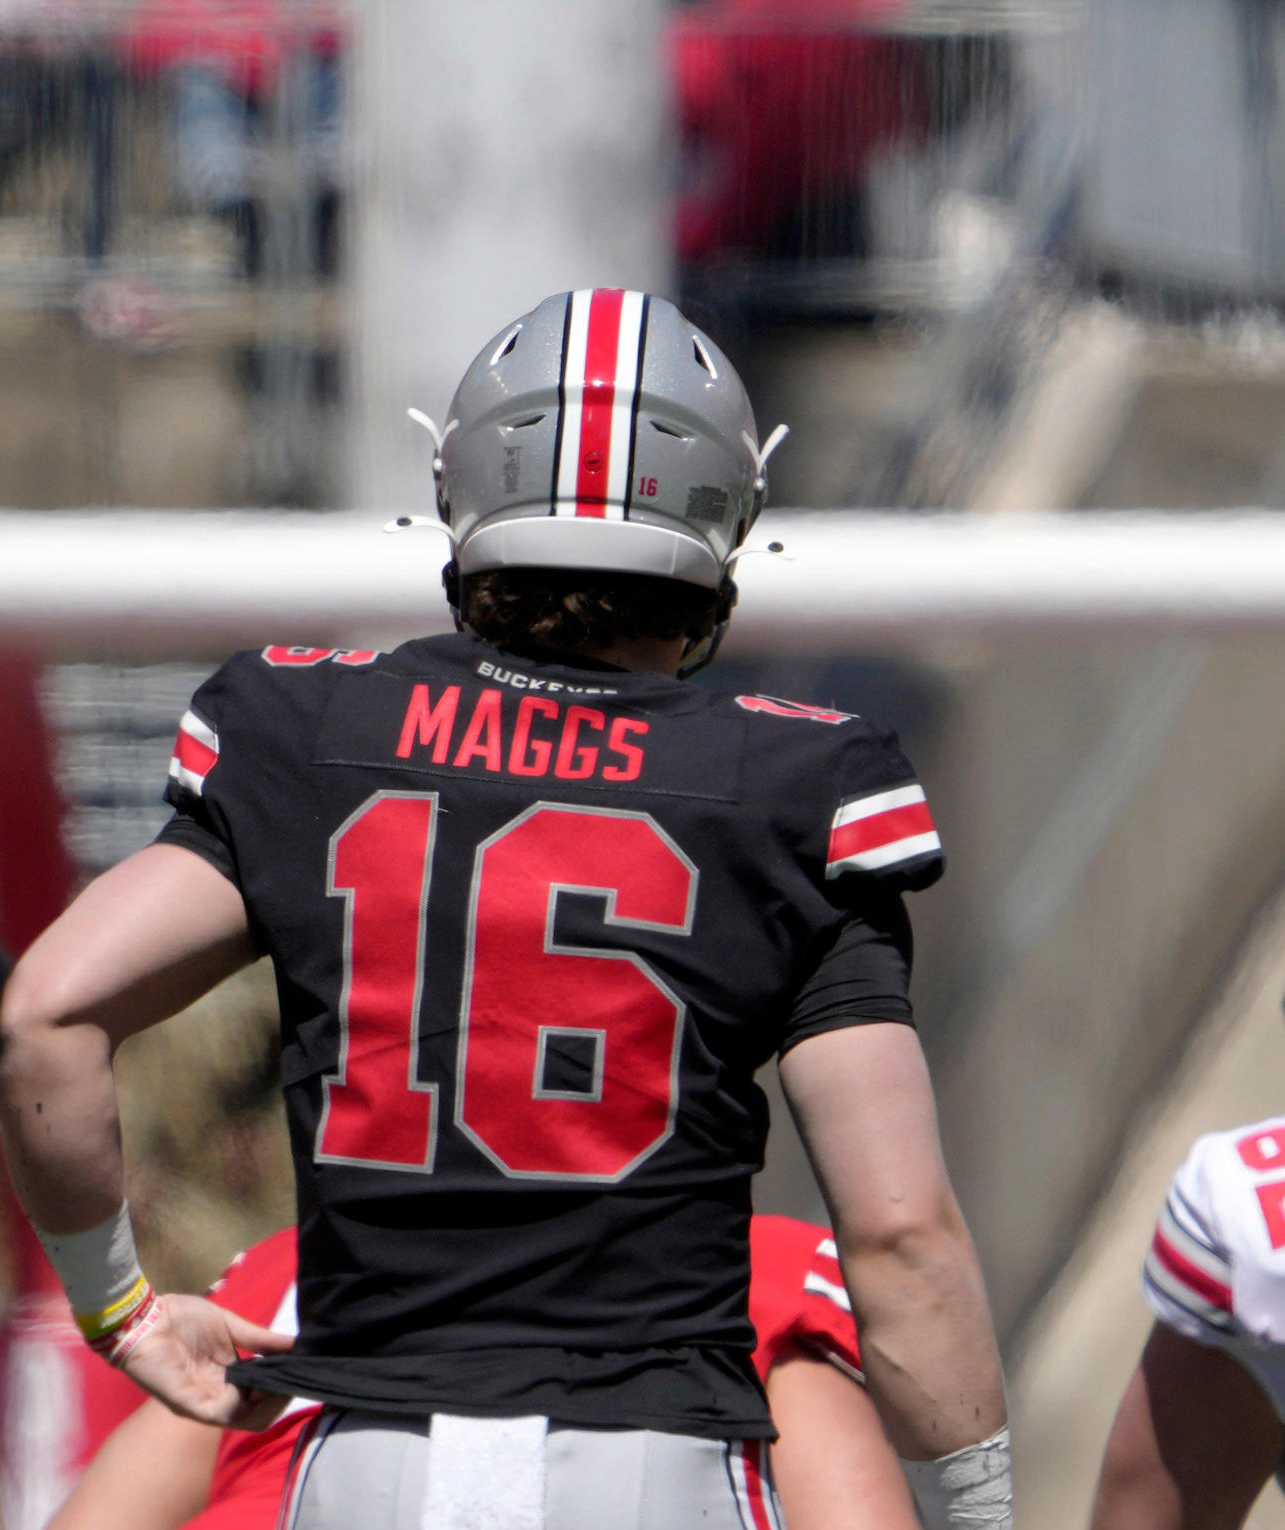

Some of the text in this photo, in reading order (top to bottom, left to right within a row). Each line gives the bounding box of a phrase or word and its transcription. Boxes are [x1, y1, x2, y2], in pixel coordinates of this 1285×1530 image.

[638, 476, 659, 497] 16
[395, 683, 650, 782] MAGGS
[313, 788, 700, 1183] 16
